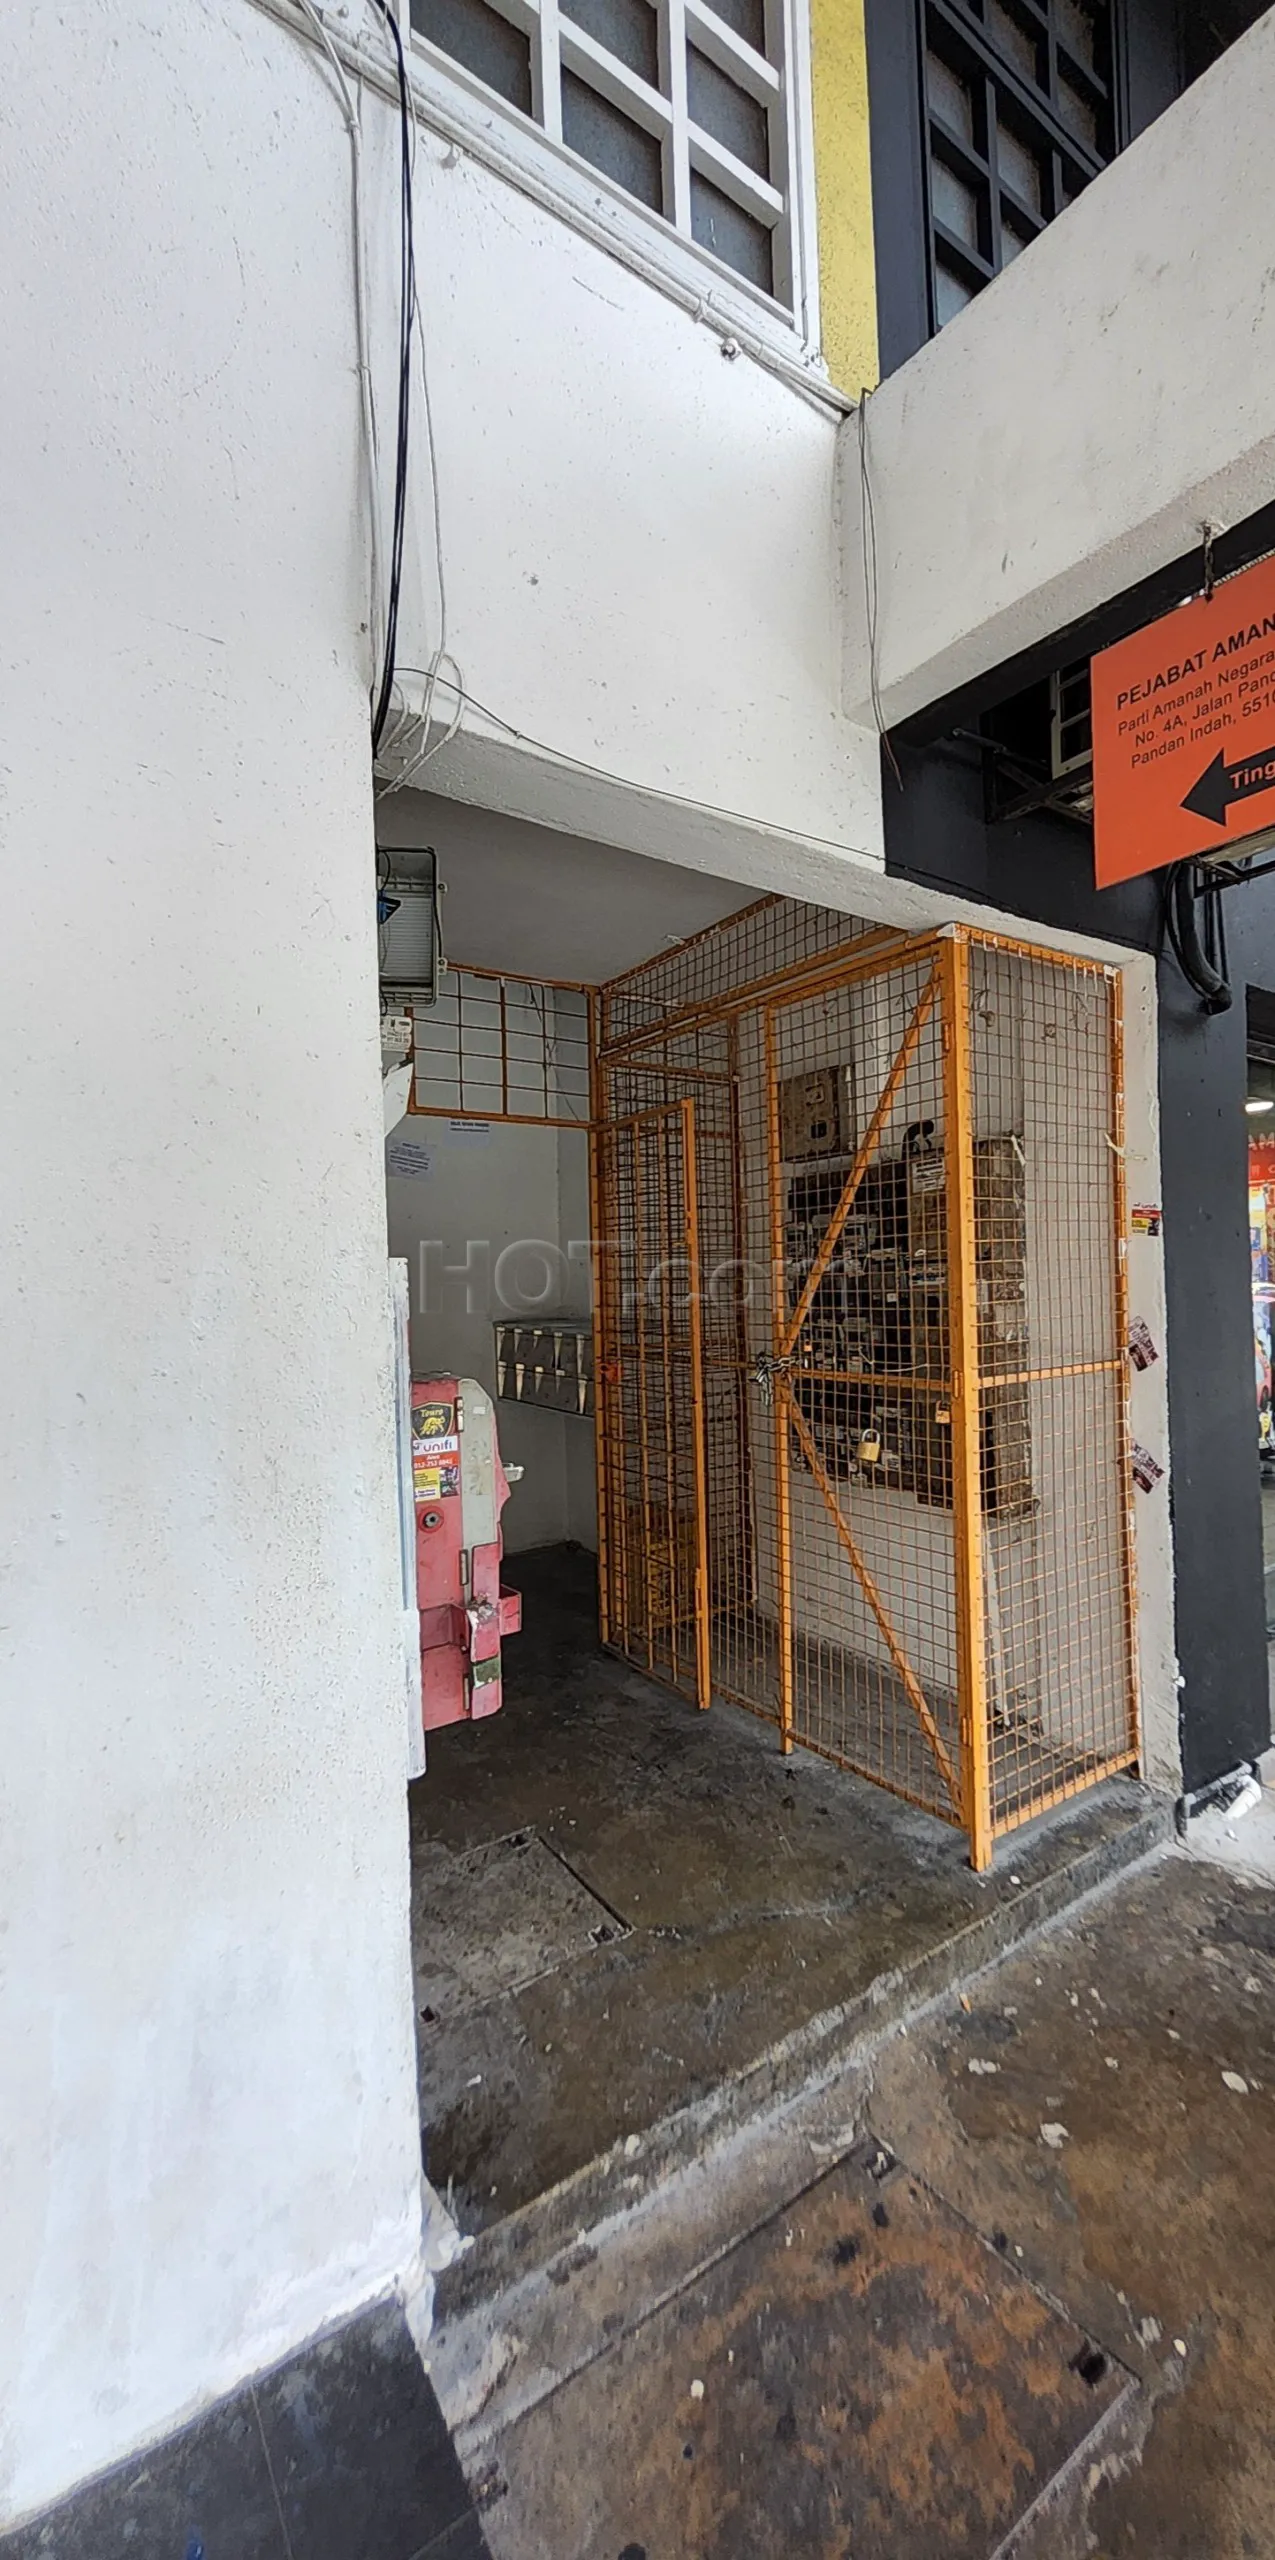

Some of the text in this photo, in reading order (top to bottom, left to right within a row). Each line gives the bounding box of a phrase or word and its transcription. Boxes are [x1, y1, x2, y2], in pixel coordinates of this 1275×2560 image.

[1117, 650, 1207, 710] PEJABAT
[1118, 650, 1275, 736] Parti Amanah Negara
[1131, 736, 1185, 768] Pandan
[1190, 713, 1236, 741] Indah,
[1135, 730, 1158, 747] No.
[1163, 715, 1187, 733] 4A,
[1192, 693, 1232, 720] Jalan
[423, 1439, 452, 1452] unifi
